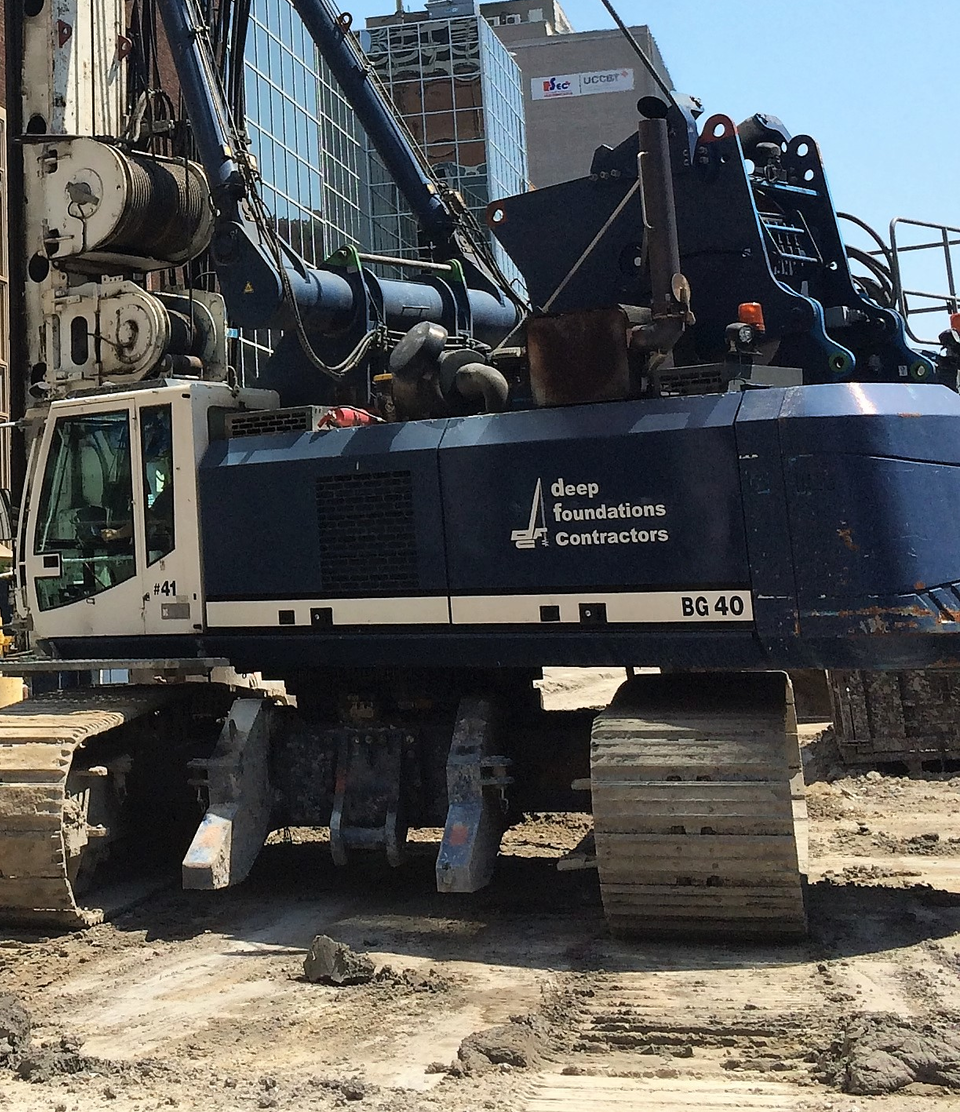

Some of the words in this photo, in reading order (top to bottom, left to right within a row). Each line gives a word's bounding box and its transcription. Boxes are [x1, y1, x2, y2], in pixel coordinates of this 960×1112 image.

[550, 478, 599, 498] deep
[553, 502, 666, 522] foundations
[153, 580, 176, 596] #41
[681, 596, 709, 617] BG
[714, 595, 744, 616] 40
